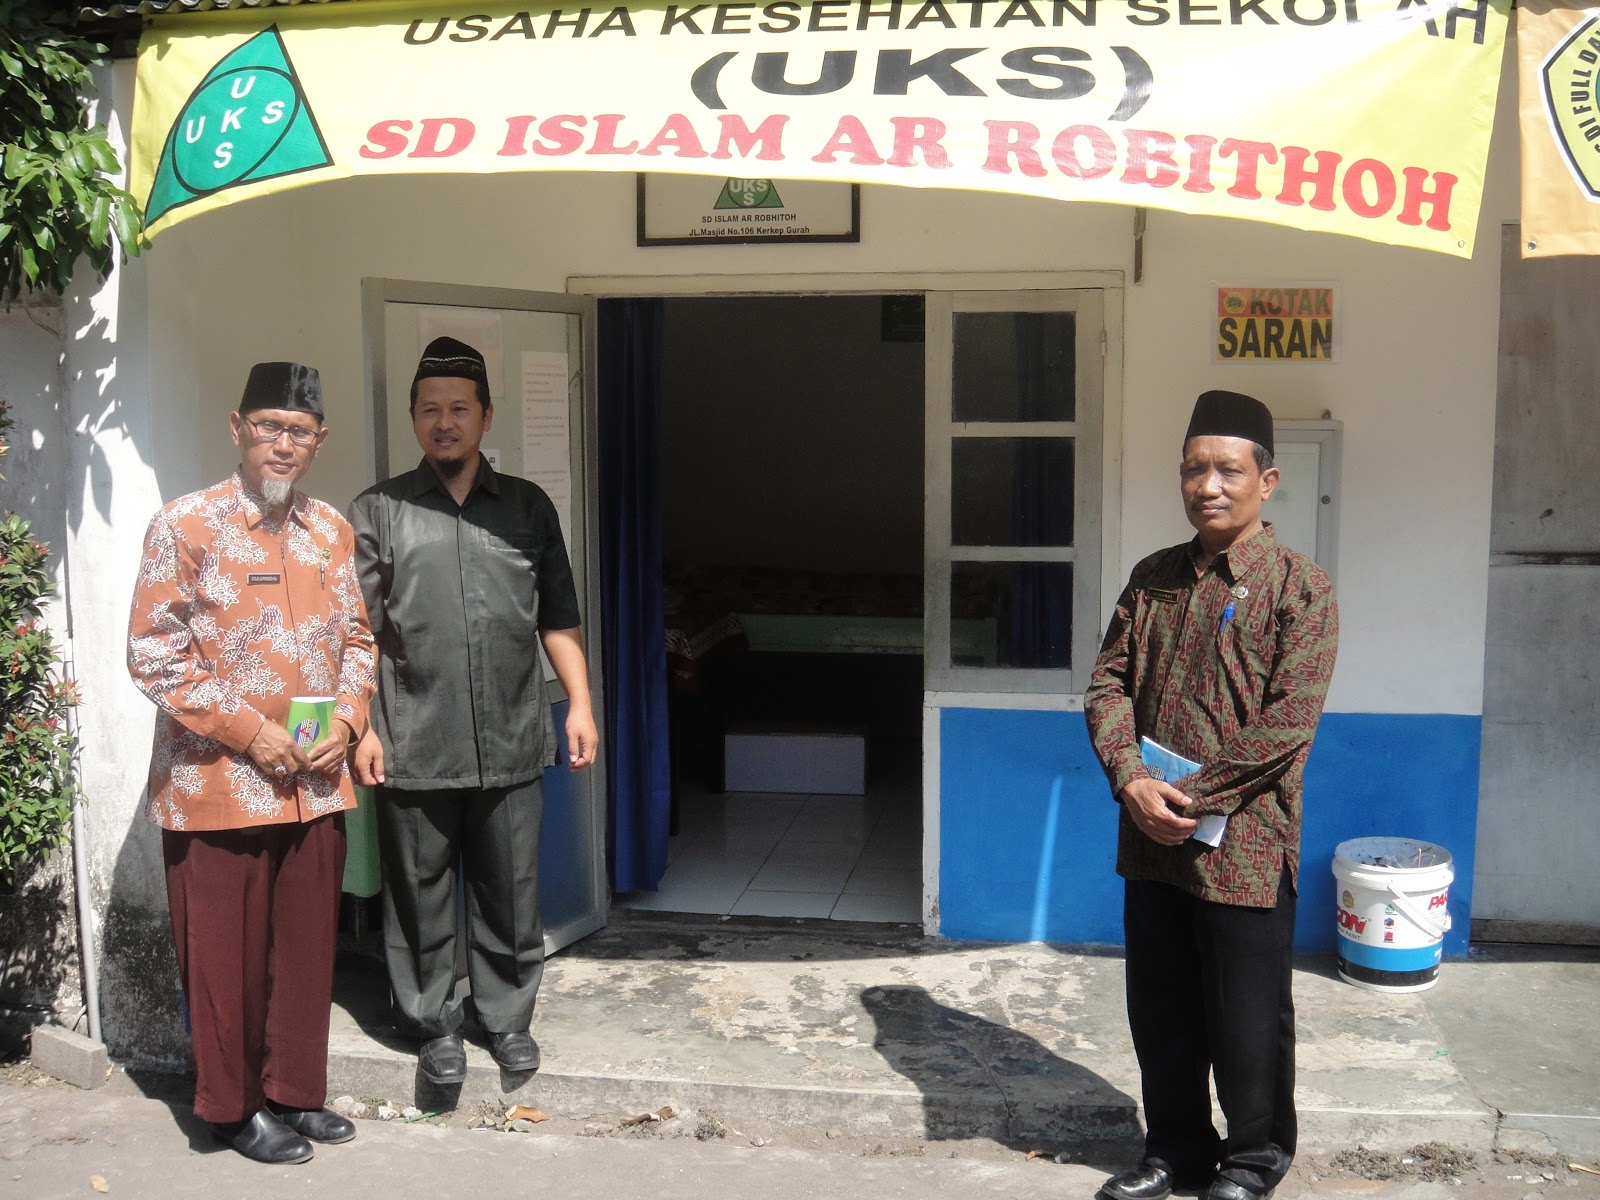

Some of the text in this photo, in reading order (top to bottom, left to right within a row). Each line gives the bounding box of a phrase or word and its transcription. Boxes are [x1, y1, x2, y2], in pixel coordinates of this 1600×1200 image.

[404, 6, 637, 45] USAHA
[660, 0, 1097, 35] KESEHATAN
[1578, 30, 1600, 65] DA
[230, 75, 256, 99] U
[691, 46, 1153, 121] (UKS)
[1571, 69, 1592, 115] FULL
[213, 142, 232, 169] S
[359, 114, 1458, 232] SD ISLAM AR ROBITHOH
[701, 213, 797, 223] SD ISLAM AR ROBHITOH
[727, 227, 754, 235] No.106
[786, 226, 810, 235] Gurah
[1250, 288, 1331, 316] KOTAK
[1218, 317, 1332, 358] SARAN
